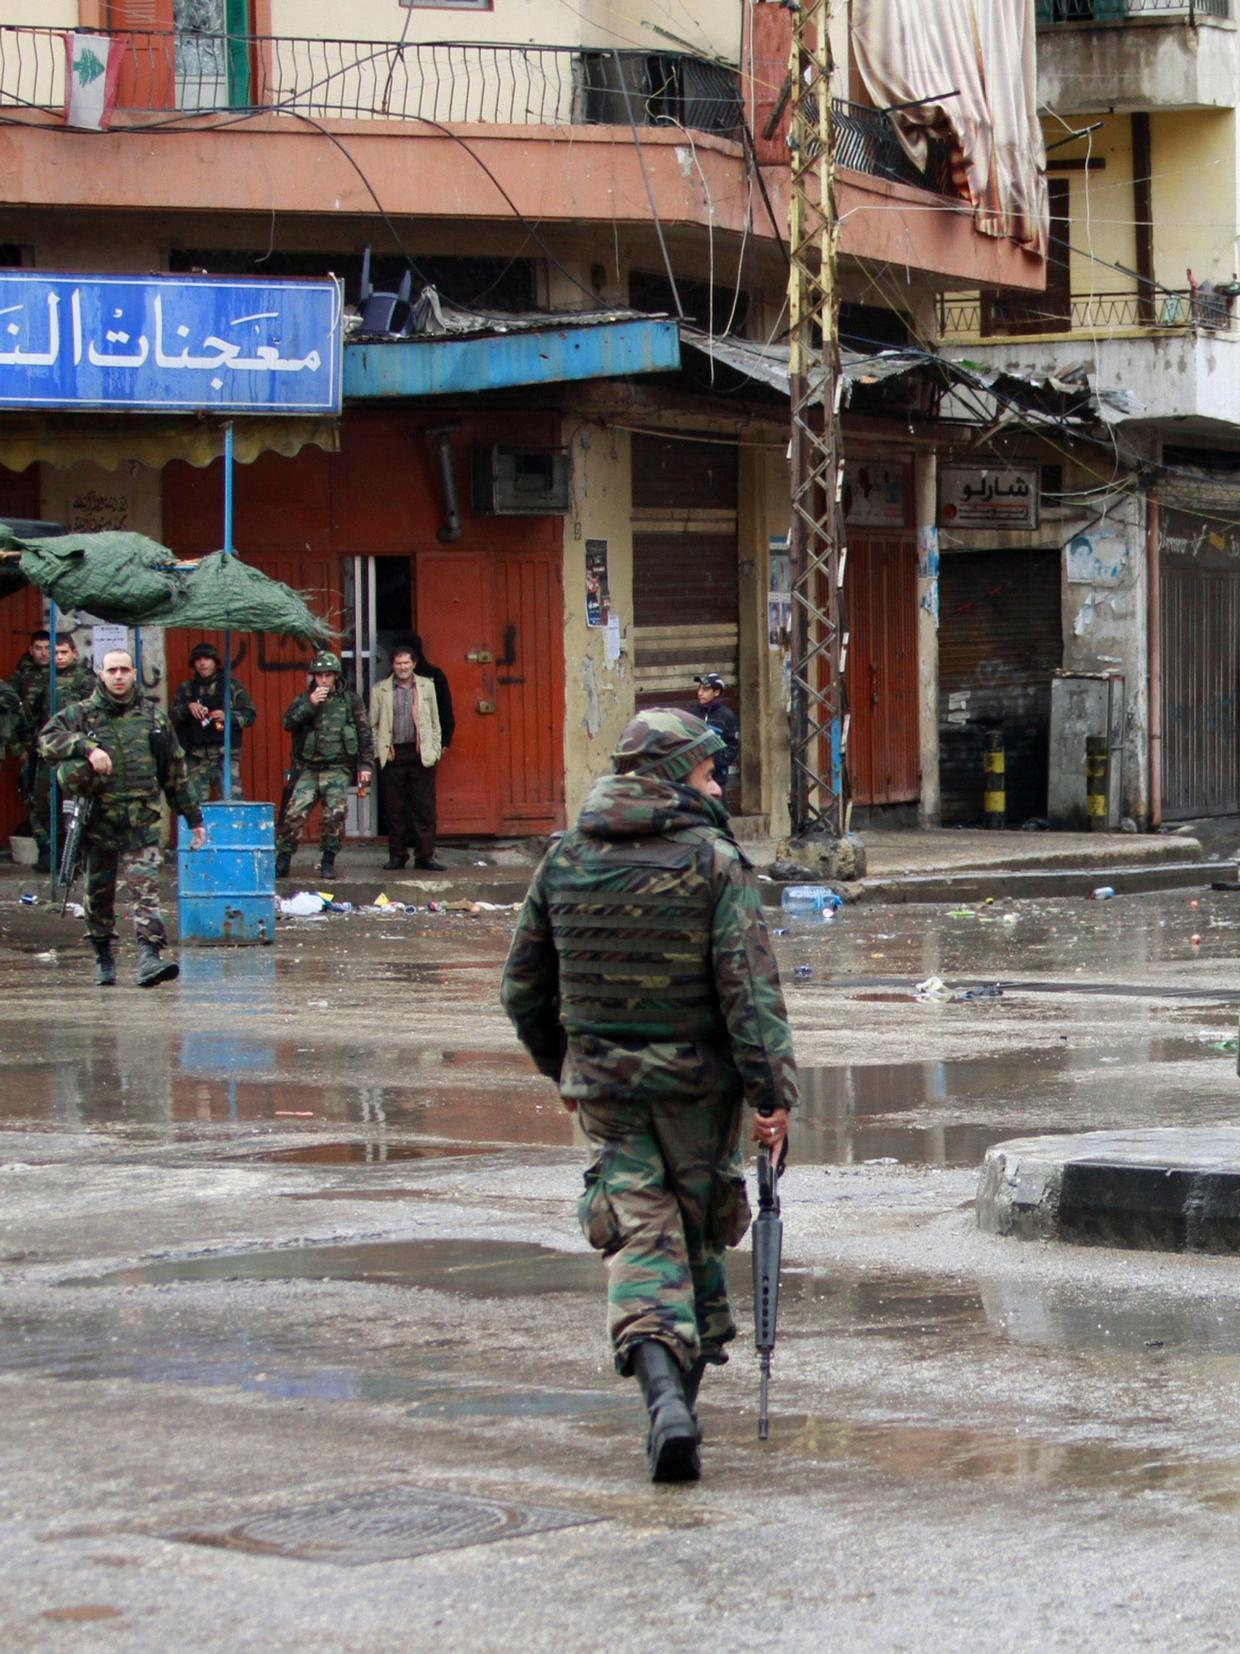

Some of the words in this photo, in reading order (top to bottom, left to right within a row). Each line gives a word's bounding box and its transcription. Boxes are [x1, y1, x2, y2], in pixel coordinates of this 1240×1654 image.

[0, 289, 82, 367] الن
[88, 291, 322, 391] معجنات
[963, 476, 1030, 502] شارلو
